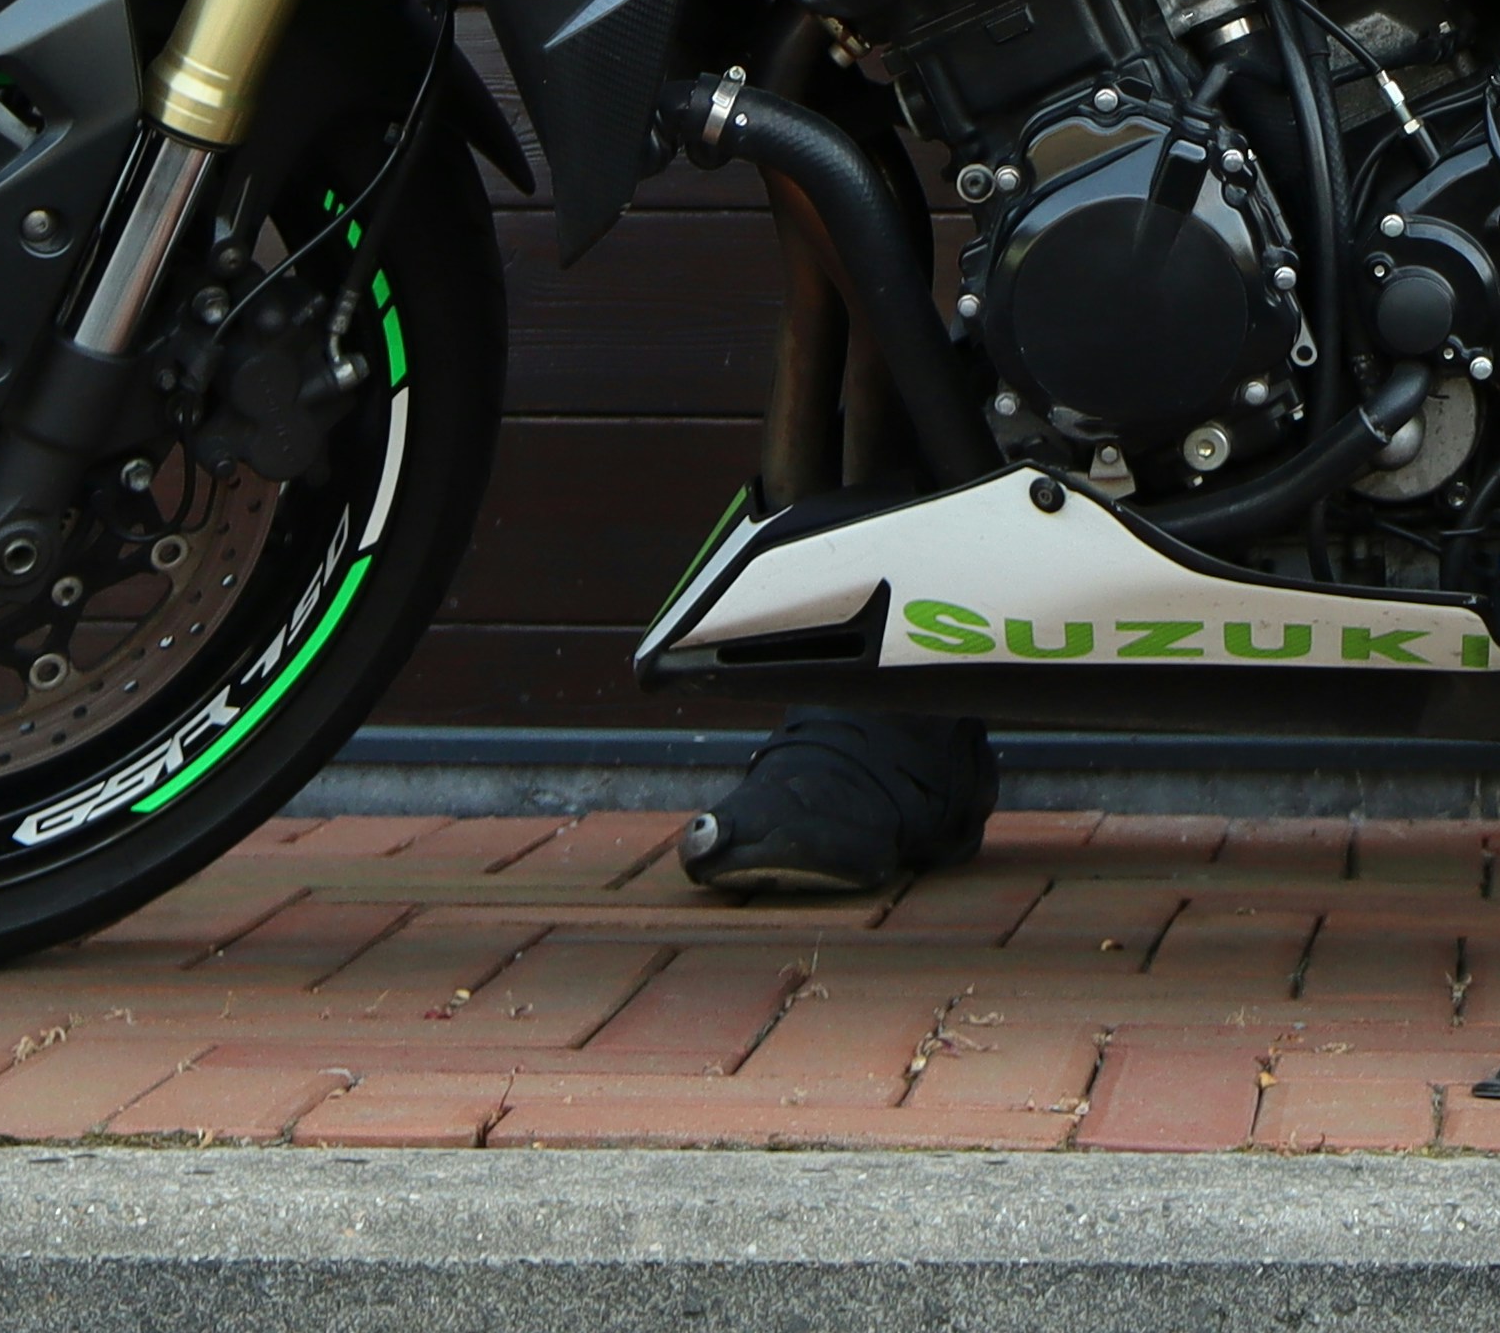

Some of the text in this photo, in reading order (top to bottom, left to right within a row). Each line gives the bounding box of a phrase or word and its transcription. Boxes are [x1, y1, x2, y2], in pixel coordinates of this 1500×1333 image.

[12, 503, 350, 845] GSR 750
[903, 599, 1491, 669] SUZUKI
